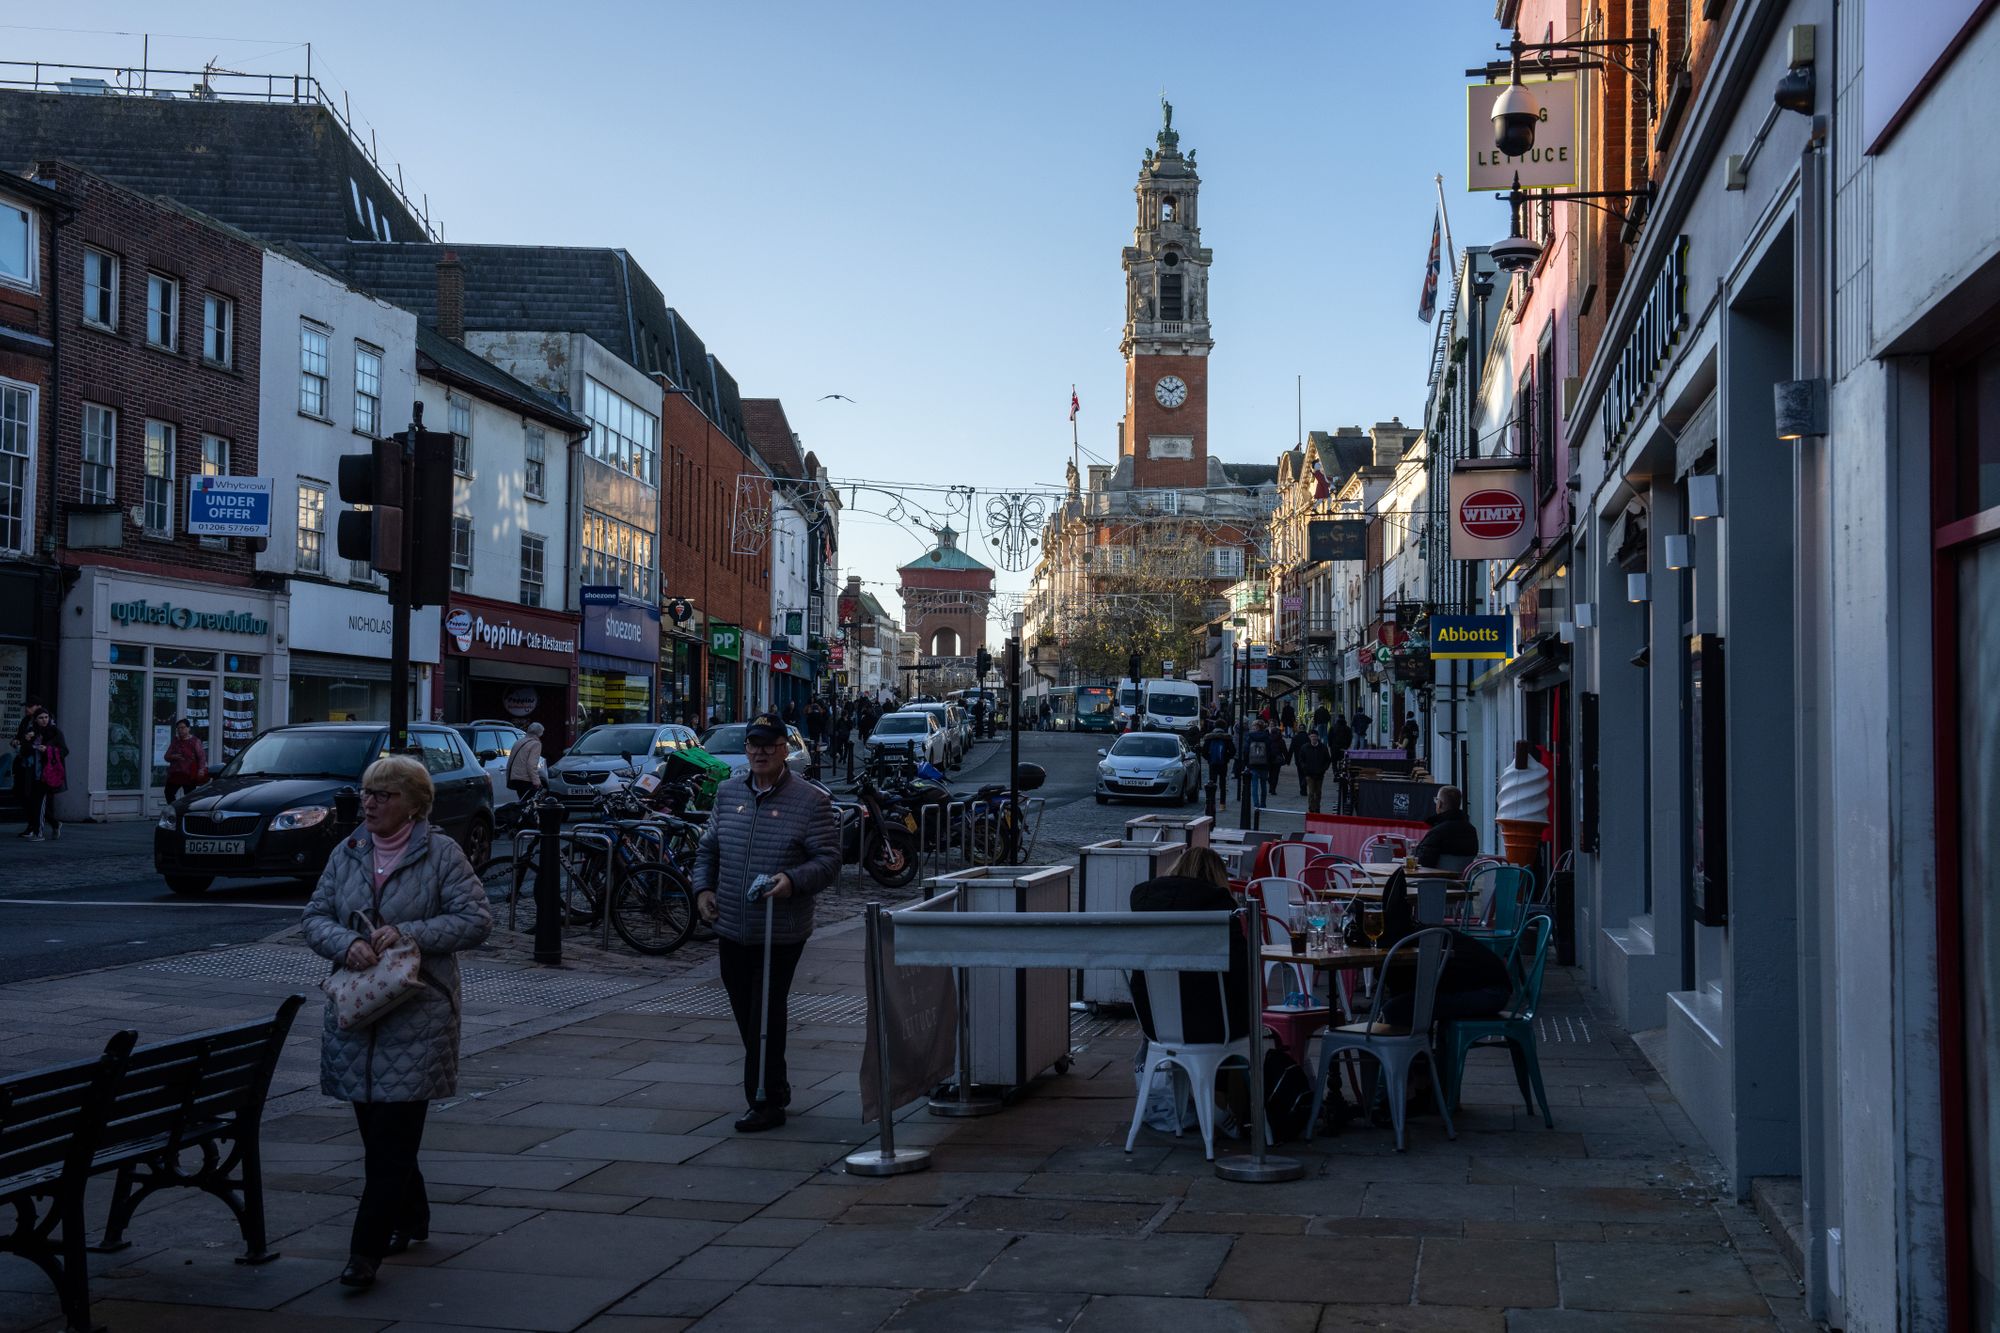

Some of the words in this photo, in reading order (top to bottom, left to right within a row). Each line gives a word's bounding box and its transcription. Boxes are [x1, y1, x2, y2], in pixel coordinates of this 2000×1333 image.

[1630, 234, 1688, 409] LETTUCE
[215, 481, 266, 490] Whybrow
[205, 495, 256, 507] UNDER
[208, 507, 251, 520] OFFER
[1462, 507, 1524, 522] WIMPY
[198, 523, 225, 531] 01206
[228, 524, 260, 533] 577667
[111, 600, 171, 626] optical
[197, 610, 269, 635] revolution
[348, 615, 392, 635] NICHOLAS
[475, 616, 523, 650] Poppins
[526, 632, 541, 649] Cafe
[542, 634, 574, 653] Restaurant
[605, 612, 642, 642] shoezone
[1437, 627, 1499, 642] Abbotts
[189, 841, 215, 852] DG57
[218, 842, 240, 853] LGY
